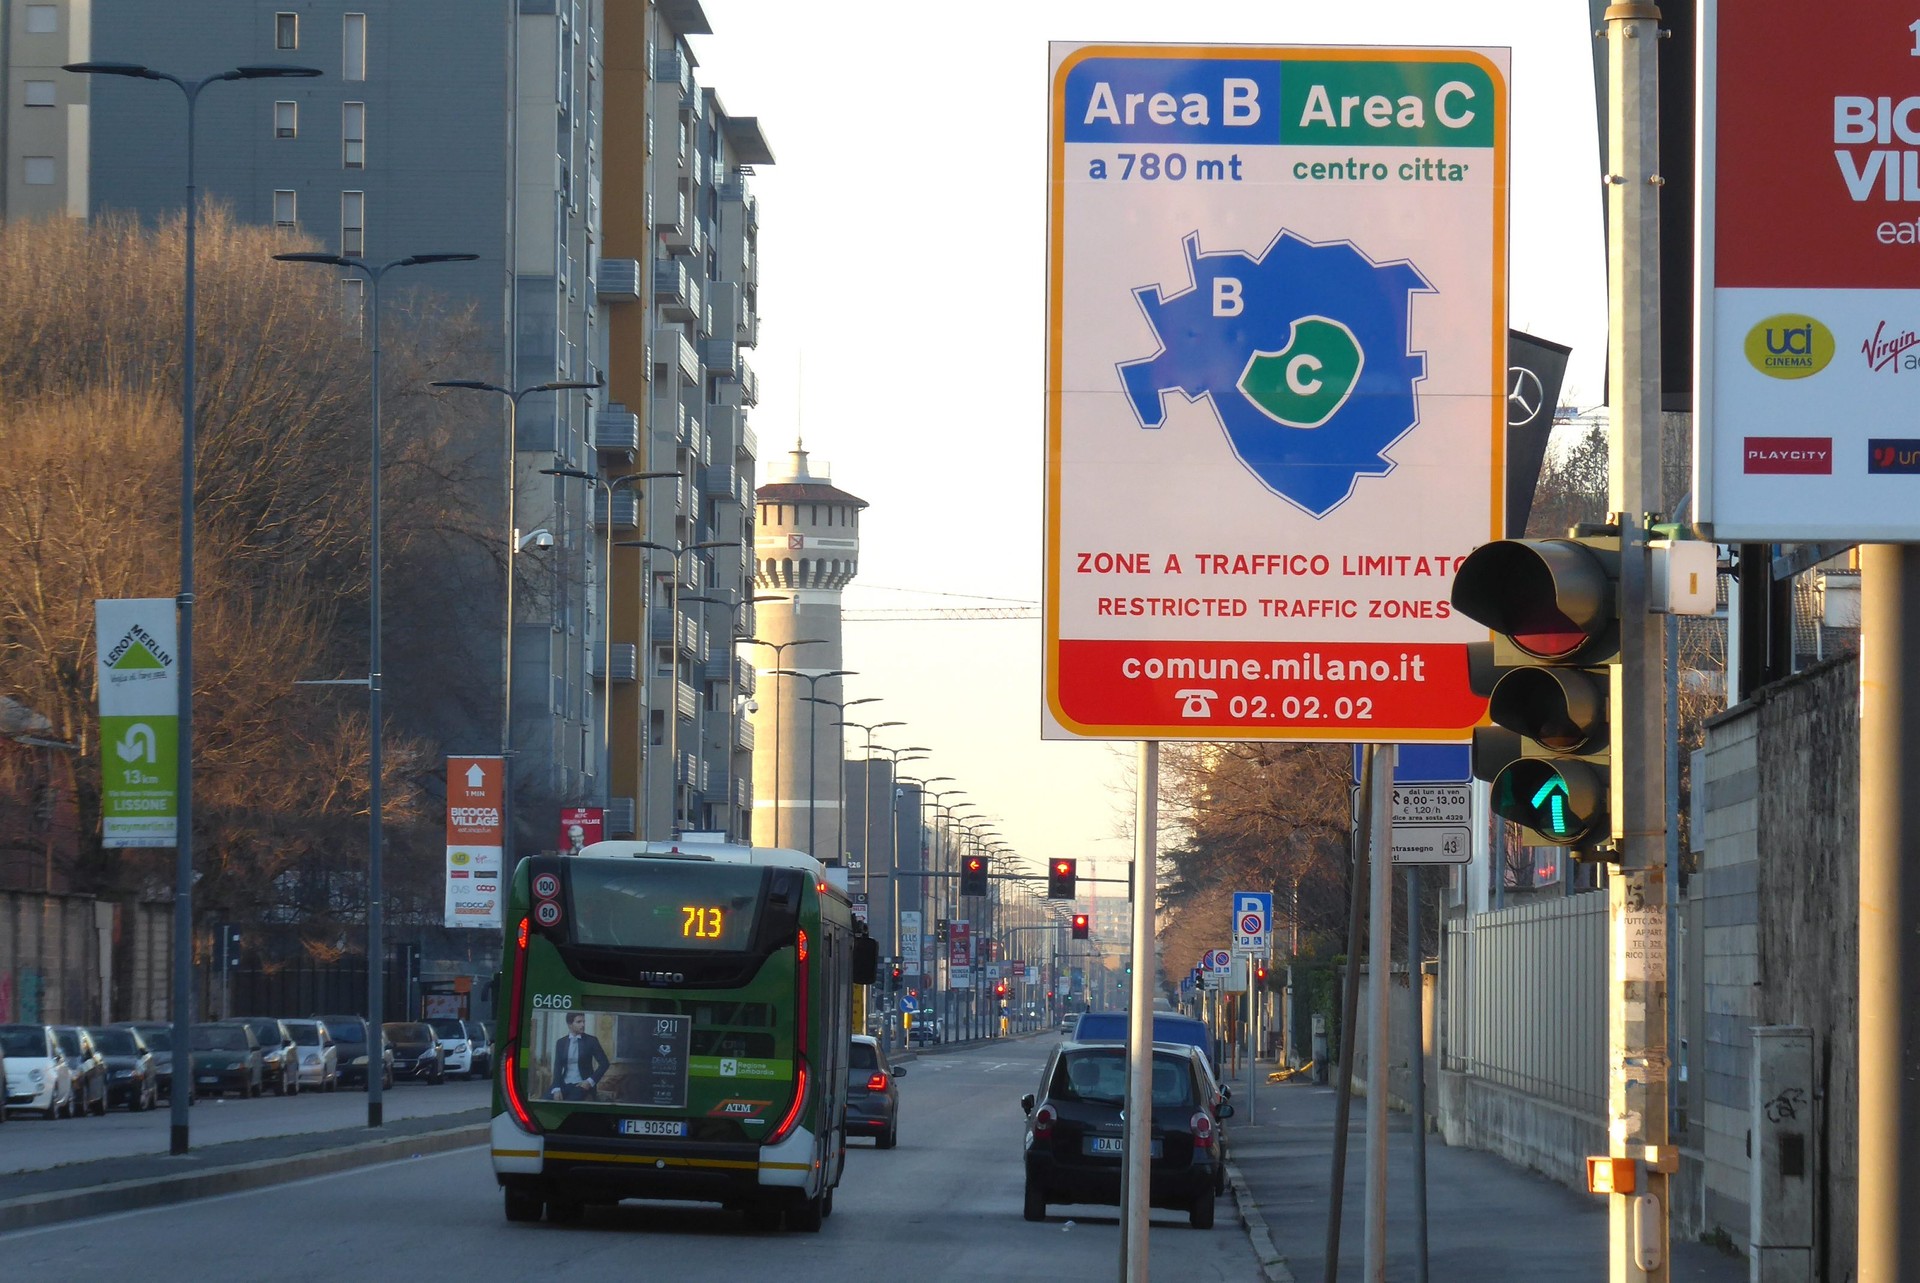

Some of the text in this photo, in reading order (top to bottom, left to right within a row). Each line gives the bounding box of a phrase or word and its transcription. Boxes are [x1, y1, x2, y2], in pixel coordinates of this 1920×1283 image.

[1083, 78, 1261, 126] Area B
[1299, 81, 1475, 128] Area C
[1089, 153, 1242, 181] a 780 mt
[1293, 157, 1388, 180] centro
[1212, 277, 1244, 316] B
[1861, 320, 1920, 373] Virgin
[1765, 357, 1813, 366] CINEMAS
[1904, 354, 1920, 370] a
[1286, 354, 1323, 396] C
[1077, 553, 1151, 574] ZONE
[1164, 554, 1182, 574] A
[1195, 554, 1330, 576] TRAFFICO
[1098, 598, 1451, 619] RESTRICTED TRAFFIC ZONES
[103, 624, 173, 668] LEROY MERLIN
[1122, 653, 1425, 682] comune.milano.it
[1229, 696, 1373, 719] 02.02.02
[123, 770, 159, 784] 13 km
[114, 799, 167, 811] LISSONE
[451, 807, 498, 816] BICOCCA
[452, 817, 499, 826] VILLAGE
[1444, 841, 1457, 854] 43
[539, 881, 554, 891] 100
[542, 908, 554, 918] 80
[682, 907, 722, 937] 713
[640, 971, 684, 983] IVECO
[533, 994, 572, 1009] 6466
[657, 1020, 677, 1032] 1911
[725, 1104, 751, 1113] ATM
[626, 1121, 680, 1134] FL 903GC
[1100, 1139, 1111, 1149] DA
